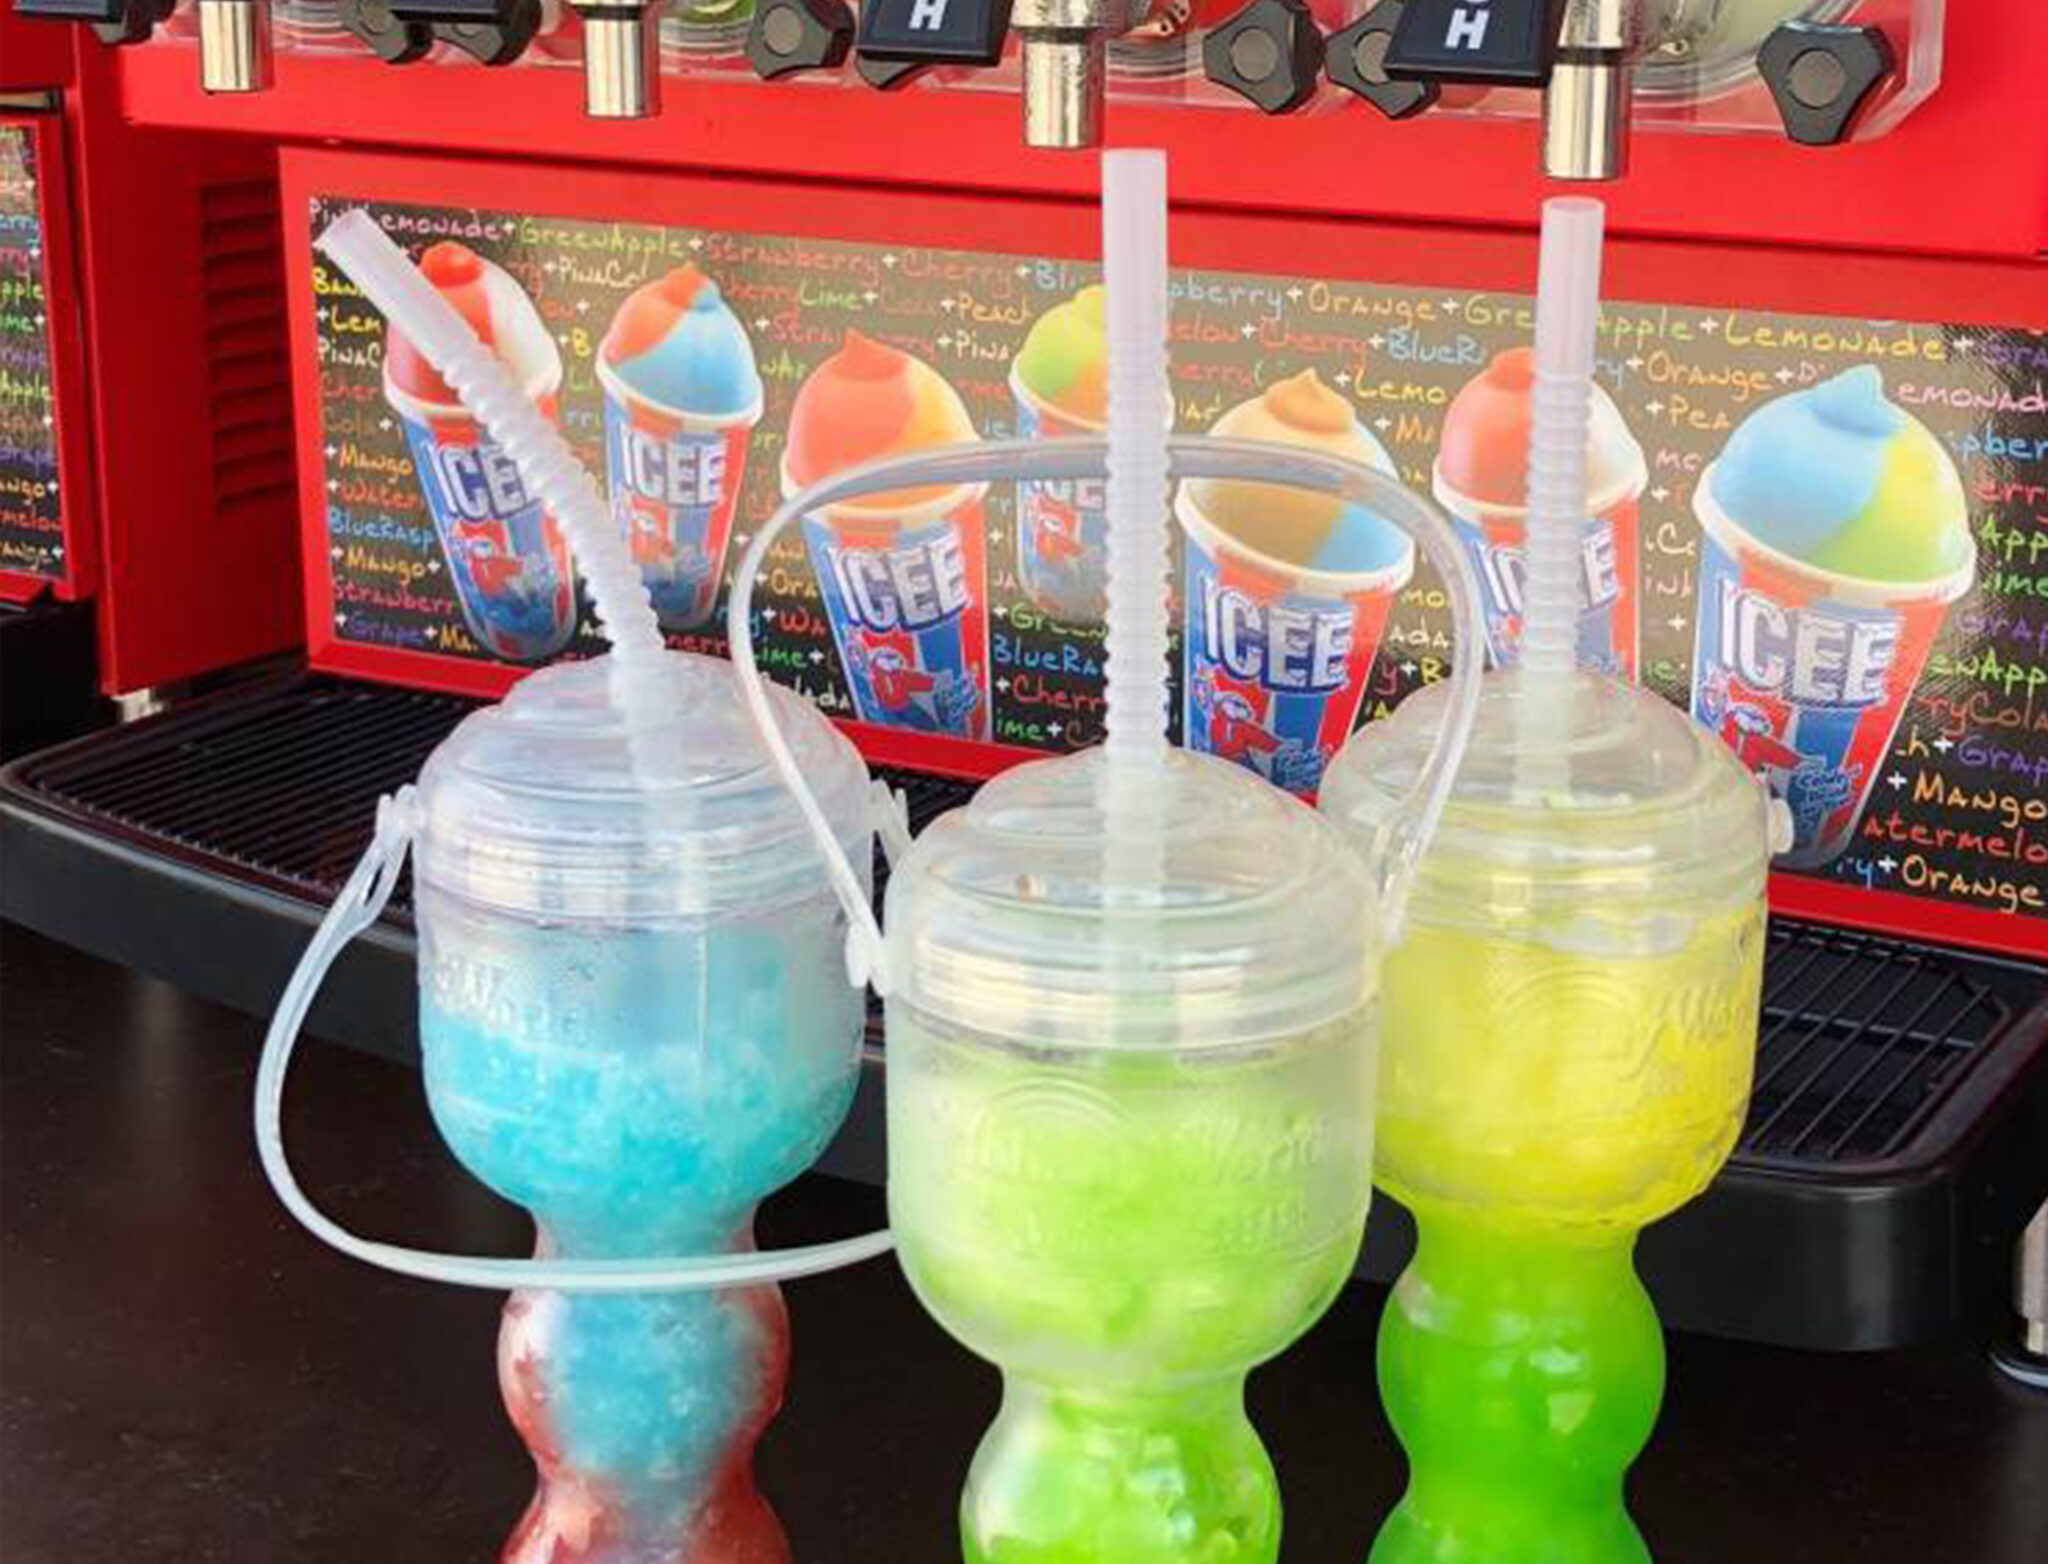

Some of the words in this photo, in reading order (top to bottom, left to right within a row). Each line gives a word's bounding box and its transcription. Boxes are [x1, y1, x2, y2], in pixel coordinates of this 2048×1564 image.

[826, 530, 974, 633] ICEE
[1199, 567, 1356, 692] ICEE
[1717, 572, 1904, 706] ICEE
[1913, 768, 2048, 829] Mango
[1902, 853, 2046, 914] Orange
